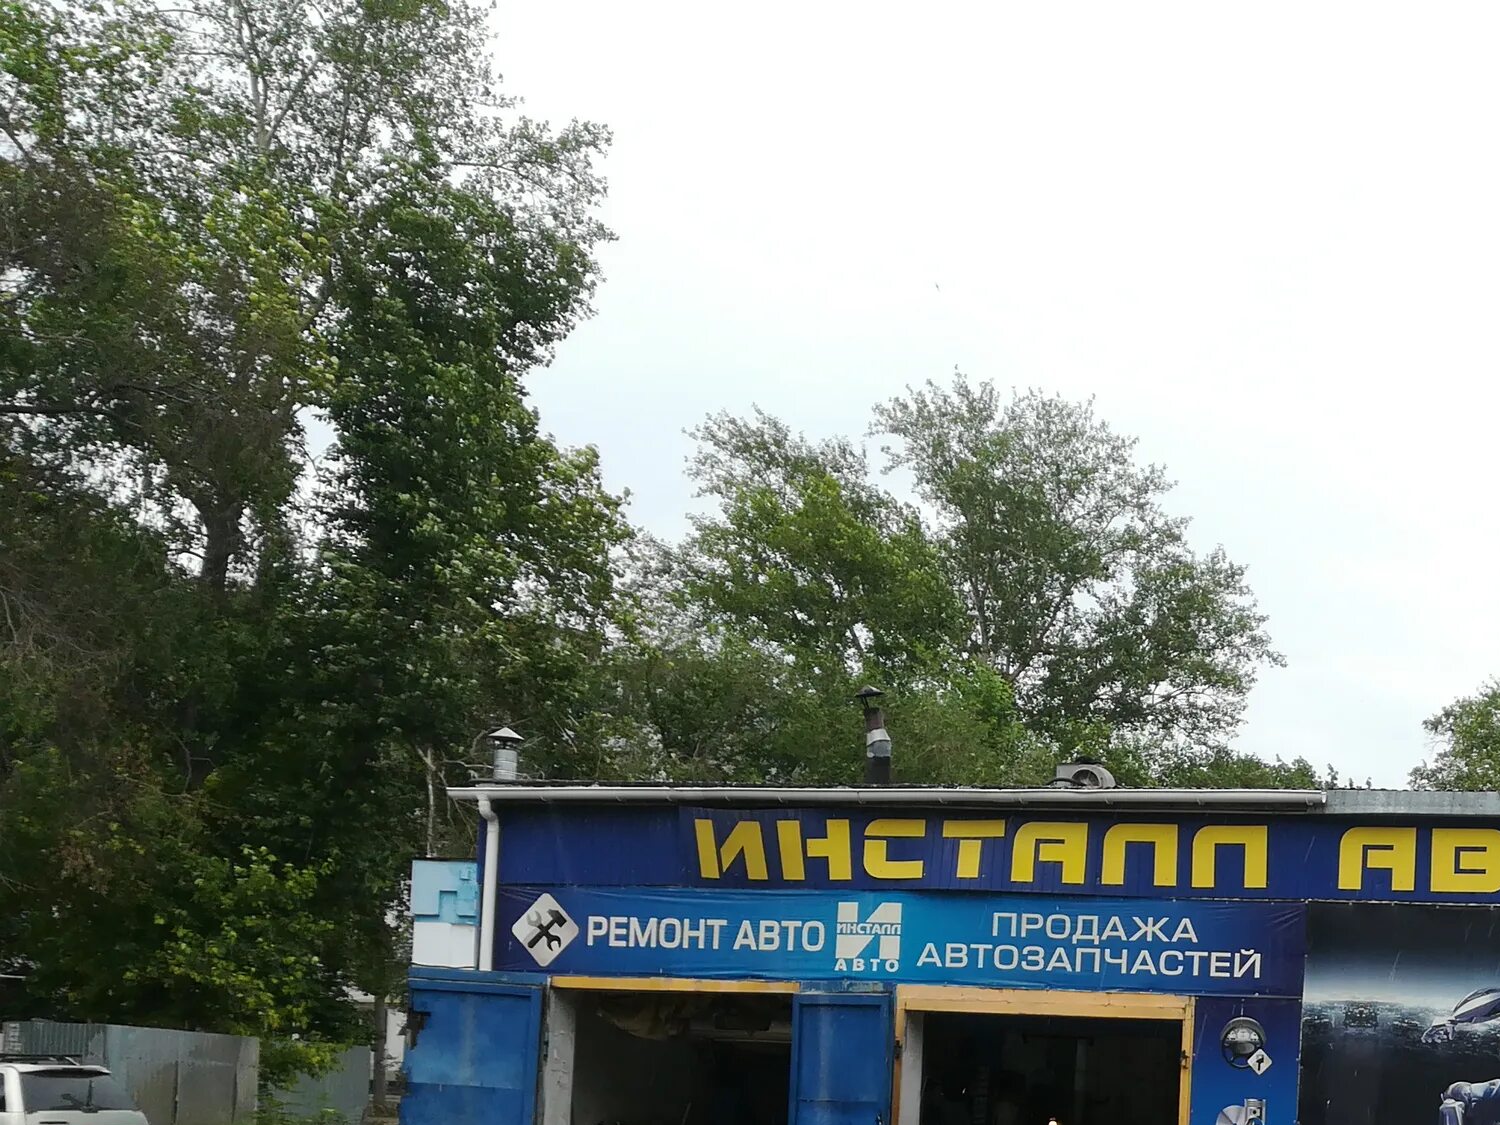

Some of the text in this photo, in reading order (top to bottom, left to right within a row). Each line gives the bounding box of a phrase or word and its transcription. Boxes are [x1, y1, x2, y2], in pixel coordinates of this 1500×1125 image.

[586, 915, 826, 953] РЕМОНТ АВТО
[991, 911, 1199, 944] ПРОДАЖА
[833, 957, 900, 973] АВТО
[916, 942, 1262, 979] АВТОЗАПЧАСТЕЙ
